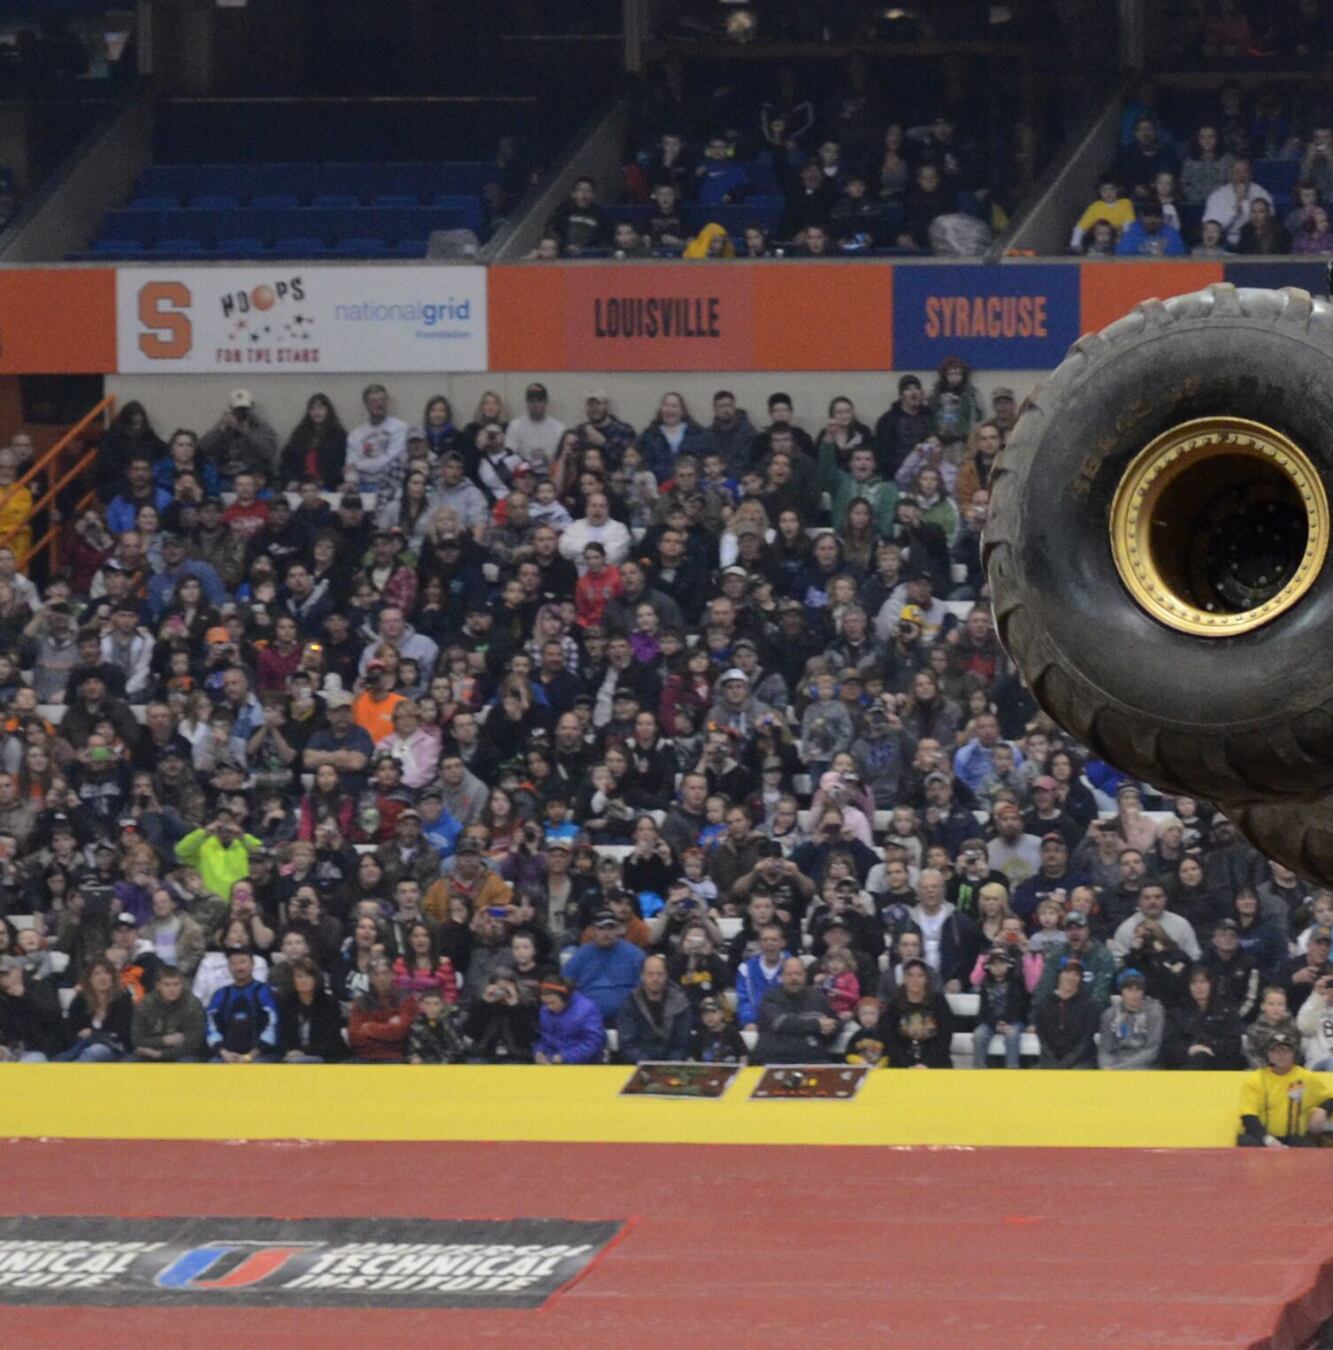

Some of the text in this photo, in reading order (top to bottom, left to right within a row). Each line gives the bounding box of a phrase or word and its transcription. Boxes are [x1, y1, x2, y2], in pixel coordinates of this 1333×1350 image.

[594, 298, 720, 338] LOUISVILLE
[925, 296, 1047, 338] SYRACUSE
[216, 349, 243, 364] FOR
[0, 1252, 138, 1273] NICAL
[308, 1253, 562, 1276] TECHNICAL
[284, 1275, 540, 1291] INSTITUTE
